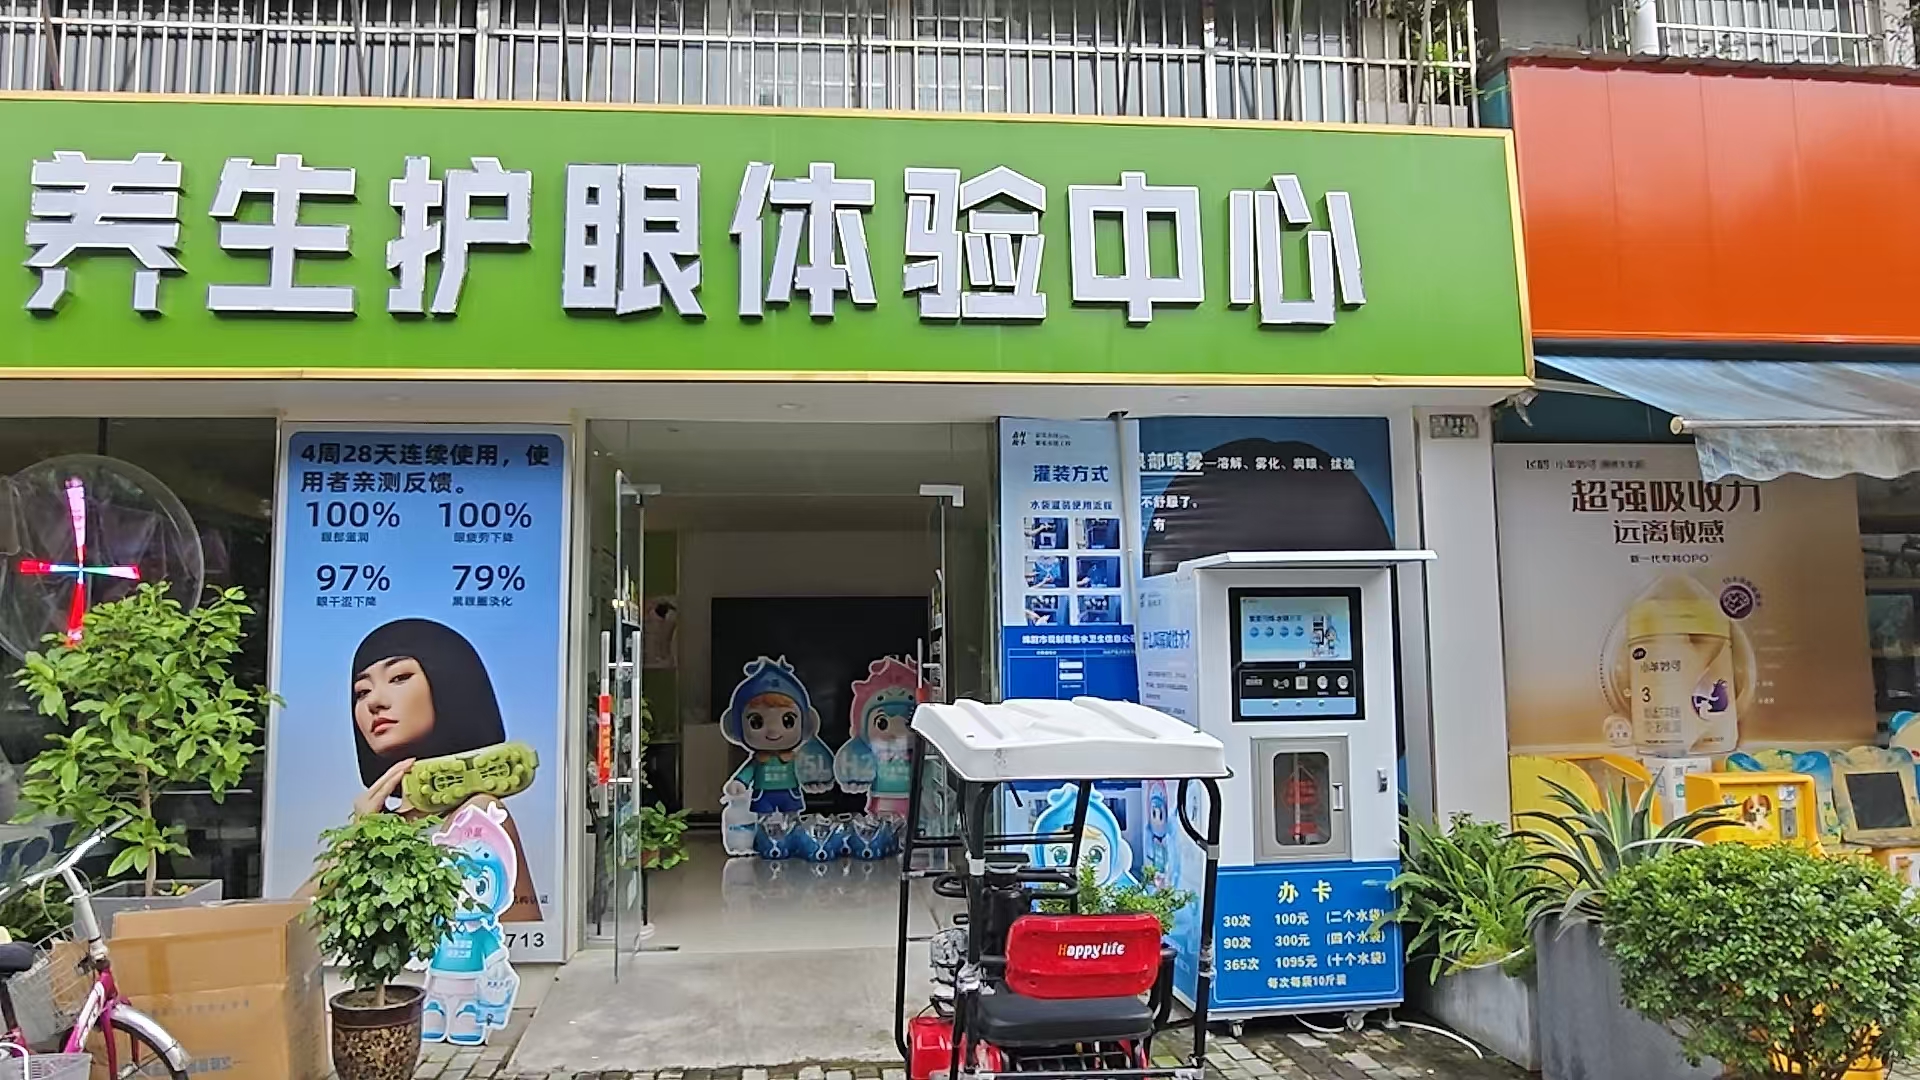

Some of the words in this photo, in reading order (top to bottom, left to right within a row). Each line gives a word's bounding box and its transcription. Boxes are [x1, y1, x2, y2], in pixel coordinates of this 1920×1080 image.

[24, 151, 1366, 328] 养生护眼体验中心
[1032, 464, 1109, 483] 灌装方式
[1571, 478, 1762, 514] 超强吸收力
[306, 501, 401, 528] 100%
[438, 502, 533, 529] 100%
[1613, 519, 1726, 545] 远离敏感
[316, 564, 392, 592] 97%
[451, 564, 526, 592] 79%
[1641, 685, 1652, 703] 3
[1277, 879, 1333, 904] 办卡
[1222, 914, 1252, 928] 30次
[1275, 911, 1310, 926] 100元
[1057, 943, 1102, 960] Happy
[1101, 941, 1126, 956] life
[1223, 936, 1252, 950] 90次
[1275, 933, 1311, 947] 300元
[1223, 957, 1260, 971] 365次
[1275, 954, 1318, 969] 1095元
